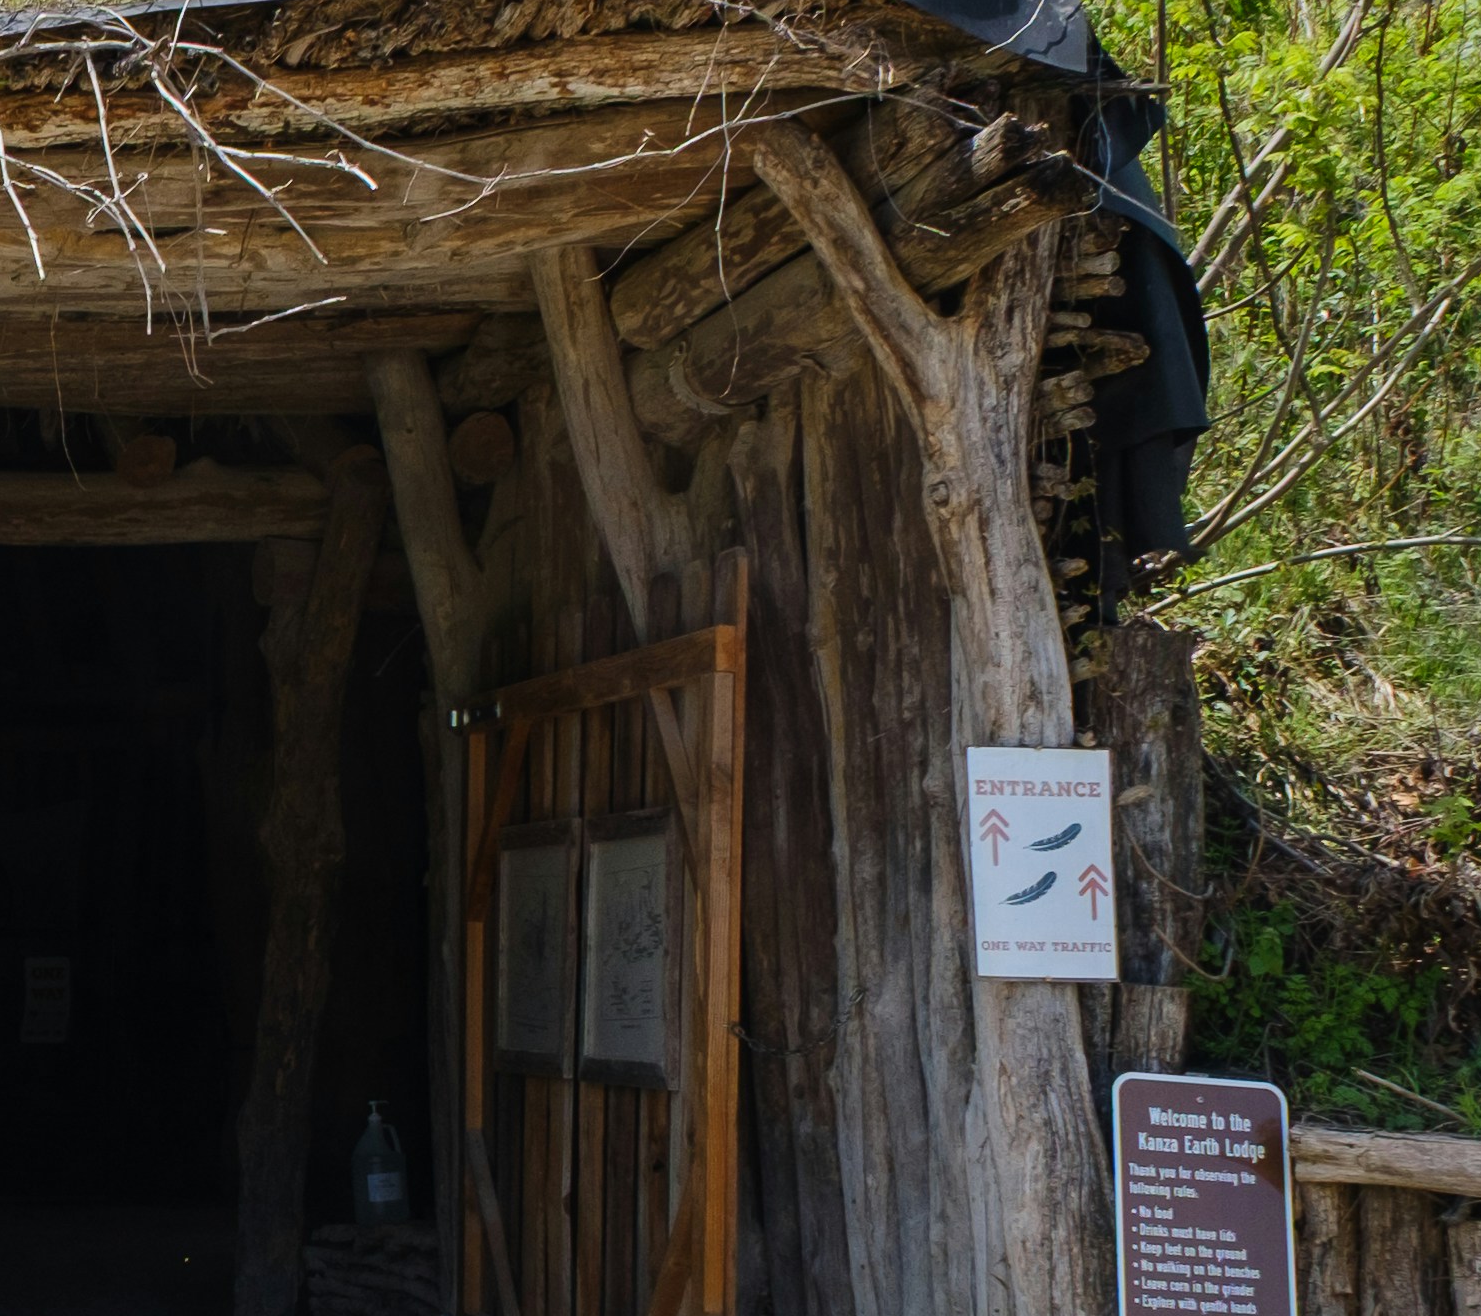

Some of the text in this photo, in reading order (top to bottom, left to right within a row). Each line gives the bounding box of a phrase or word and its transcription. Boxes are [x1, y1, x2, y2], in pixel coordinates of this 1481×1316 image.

[975, 779, 1101, 798] ENTRANCE
[981, 941, 1112, 953] ONE WAY TRAFFIC
[31, 968, 63, 980] ONE
[1149, 1106, 1251, 1132] Welcome to the
[1139, 1132, 1265, 1163] Kanza Earth Lodge
[1129, 1162, 1256, 1186] Thank you for observing the
[1129, 1182, 1170, 1200] following
[1139, 1206, 1173, 1220] No food
[1139, 1223, 1236, 1242] Drinks must have lids
[1140, 1241, 1247, 1262] Keep feet on the ground
[1141, 1259, 1261, 1280] No walking on the benches
[1141, 1277, 1255, 1298] Leave corn in the grinder
[1178, 1298, 1197, 1310] with
[1200, 1300, 1227, 1314] gentle
[1230, 1301, 1257, 1314] hands
